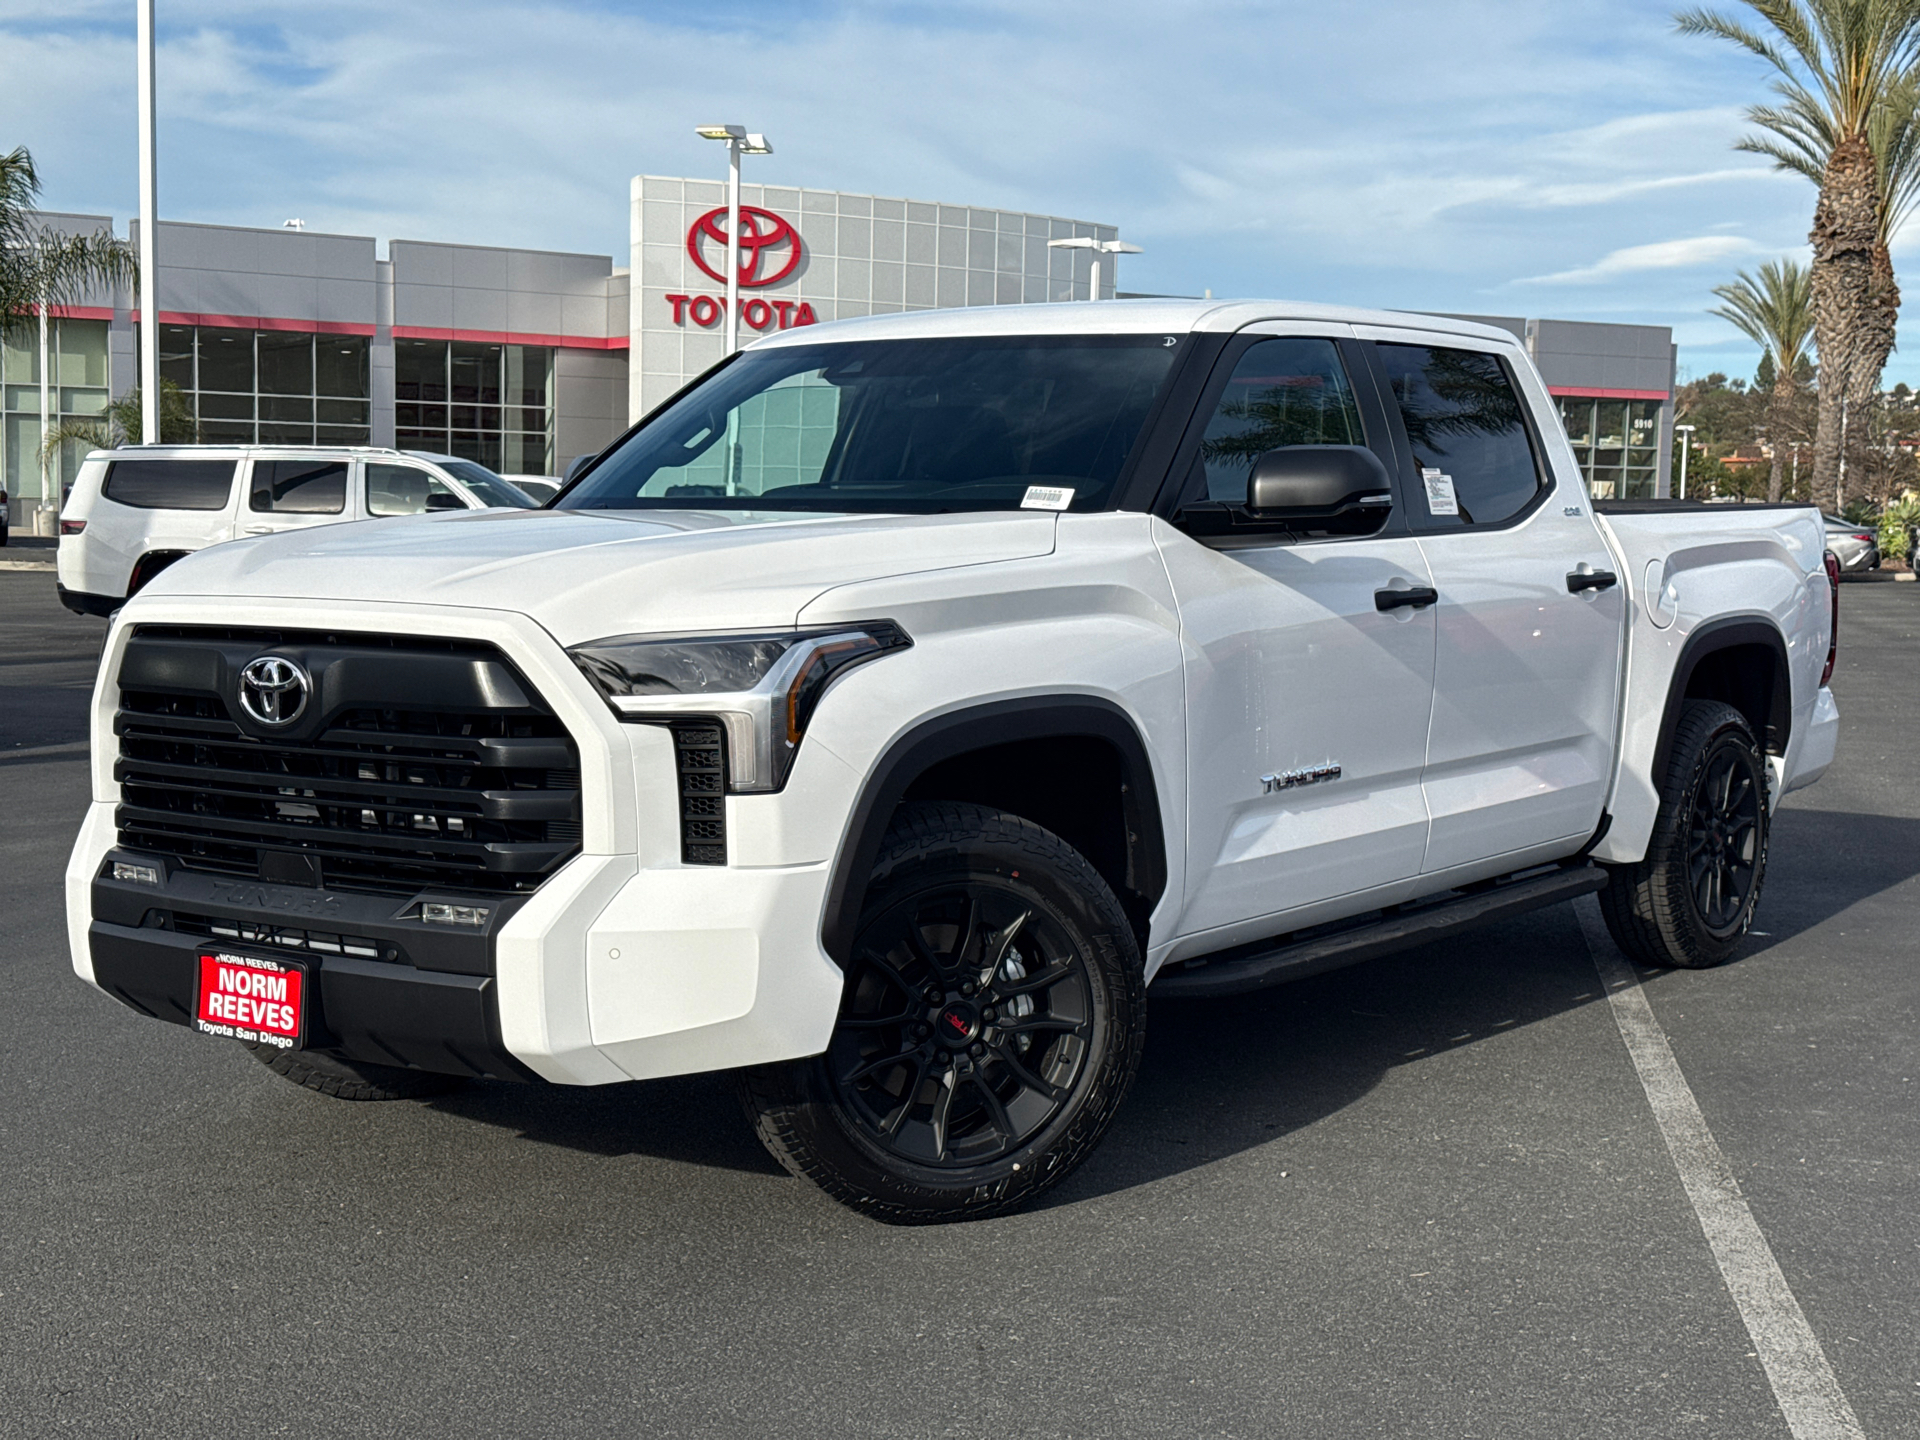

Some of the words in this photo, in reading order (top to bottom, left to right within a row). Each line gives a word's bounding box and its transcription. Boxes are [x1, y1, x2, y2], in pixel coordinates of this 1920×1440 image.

[1163, 336, 1177, 347] D
[219, 953, 245, 966] NORM
[245, 958, 279, 971] REEVES
[218, 967, 287, 1002] NORM
[208, 992, 295, 1031] REEVES
[945, 1011, 968, 1035] TRD
[197, 1019, 234, 1036] Toyota
[235, 1027, 257, 1042] San
[260, 1031, 294, 1049] Diego
